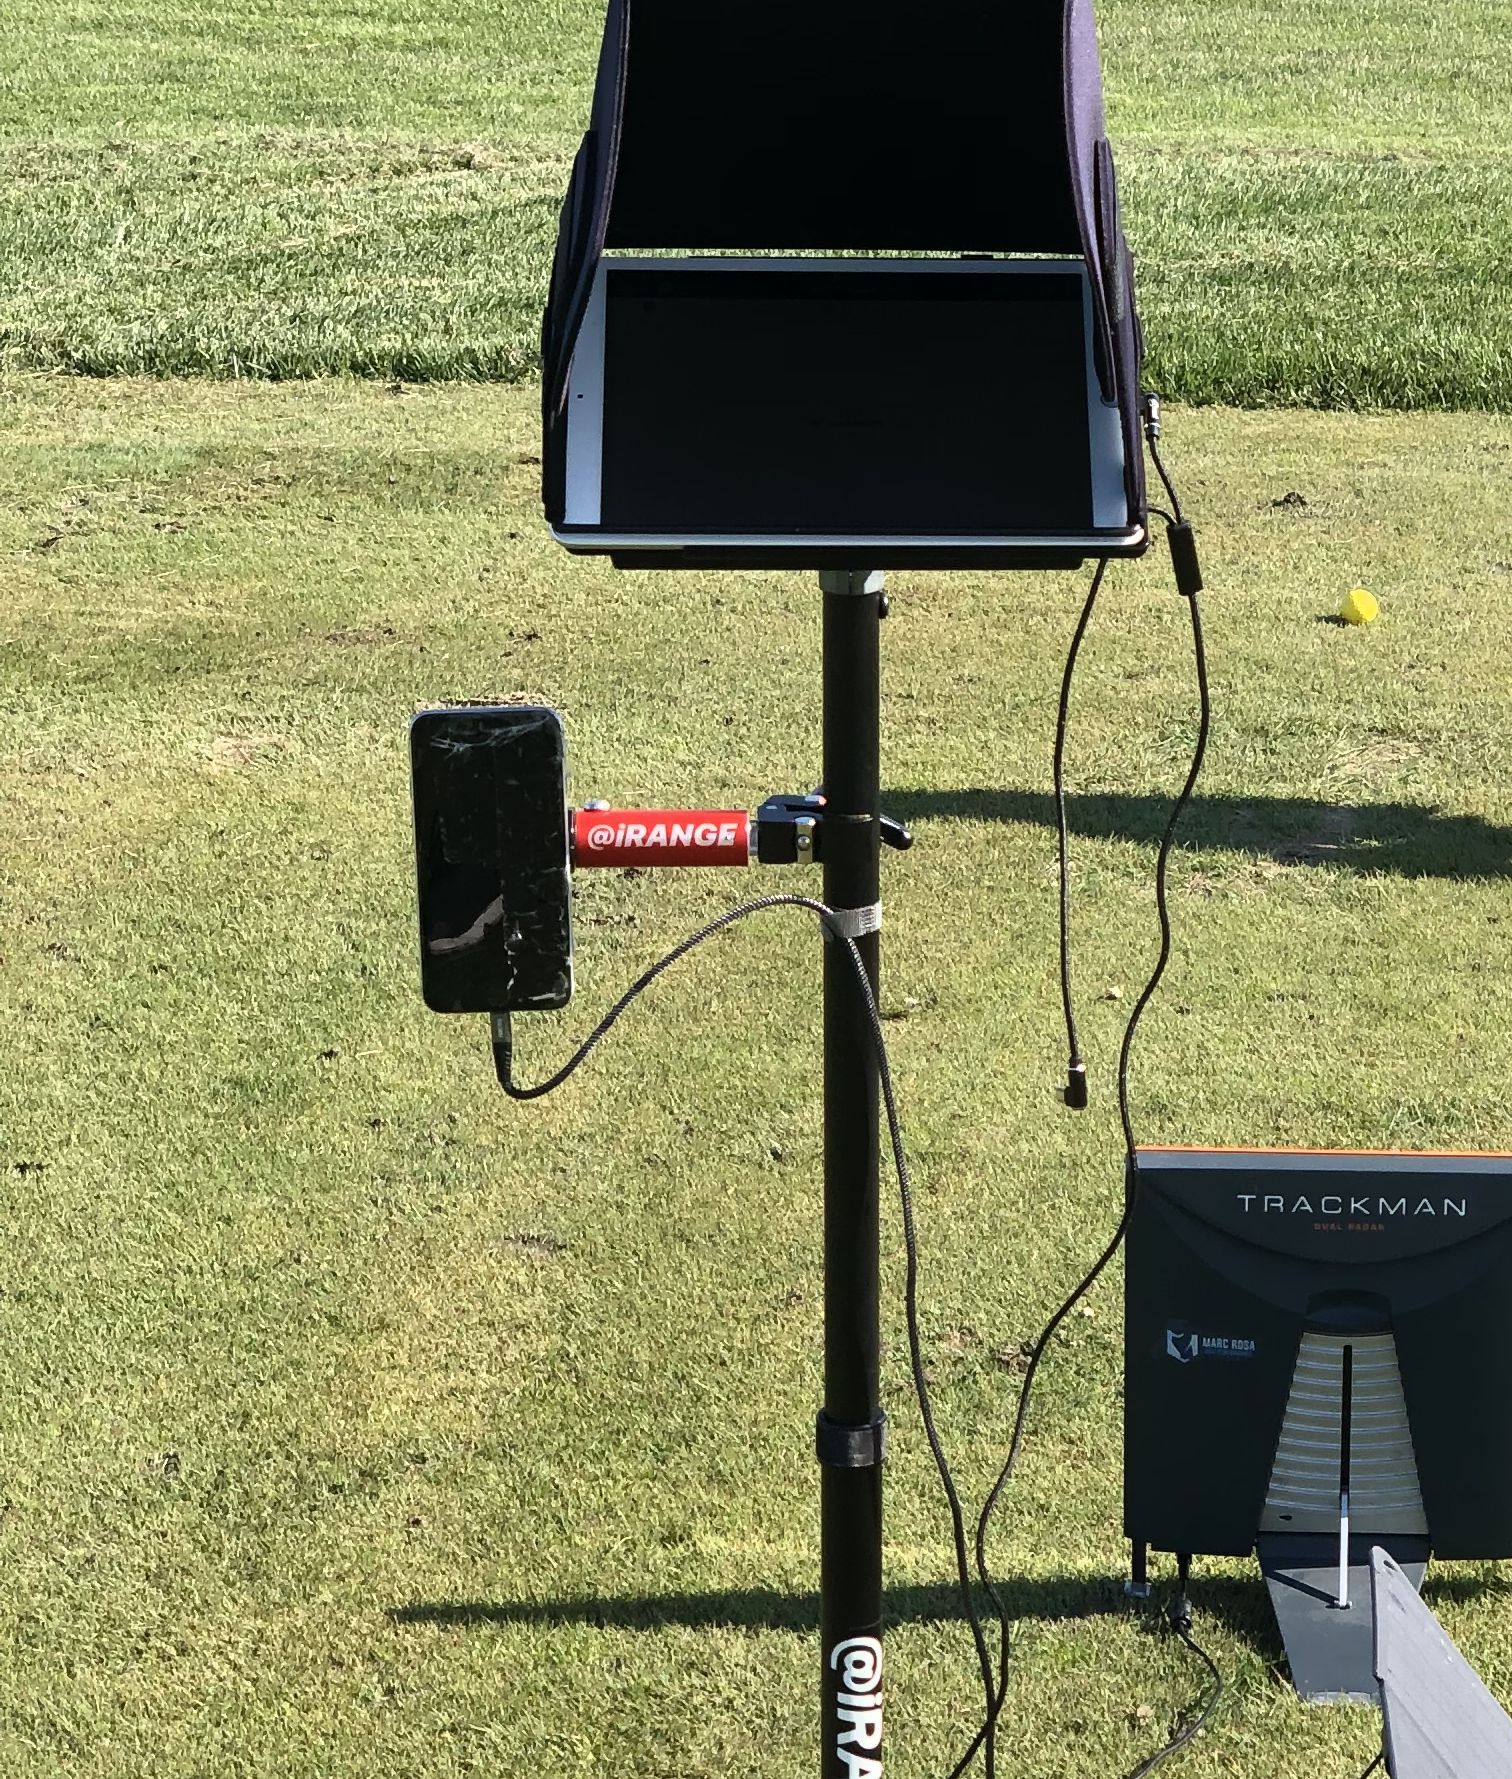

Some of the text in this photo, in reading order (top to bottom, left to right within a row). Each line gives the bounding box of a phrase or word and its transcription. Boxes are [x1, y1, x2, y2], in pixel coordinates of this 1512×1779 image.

[587, 823, 738, 850] @iRANGE
[1237, 1194, 1466, 1217] TRACKMAN
[1202, 1336, 1229, 1349] MARC
